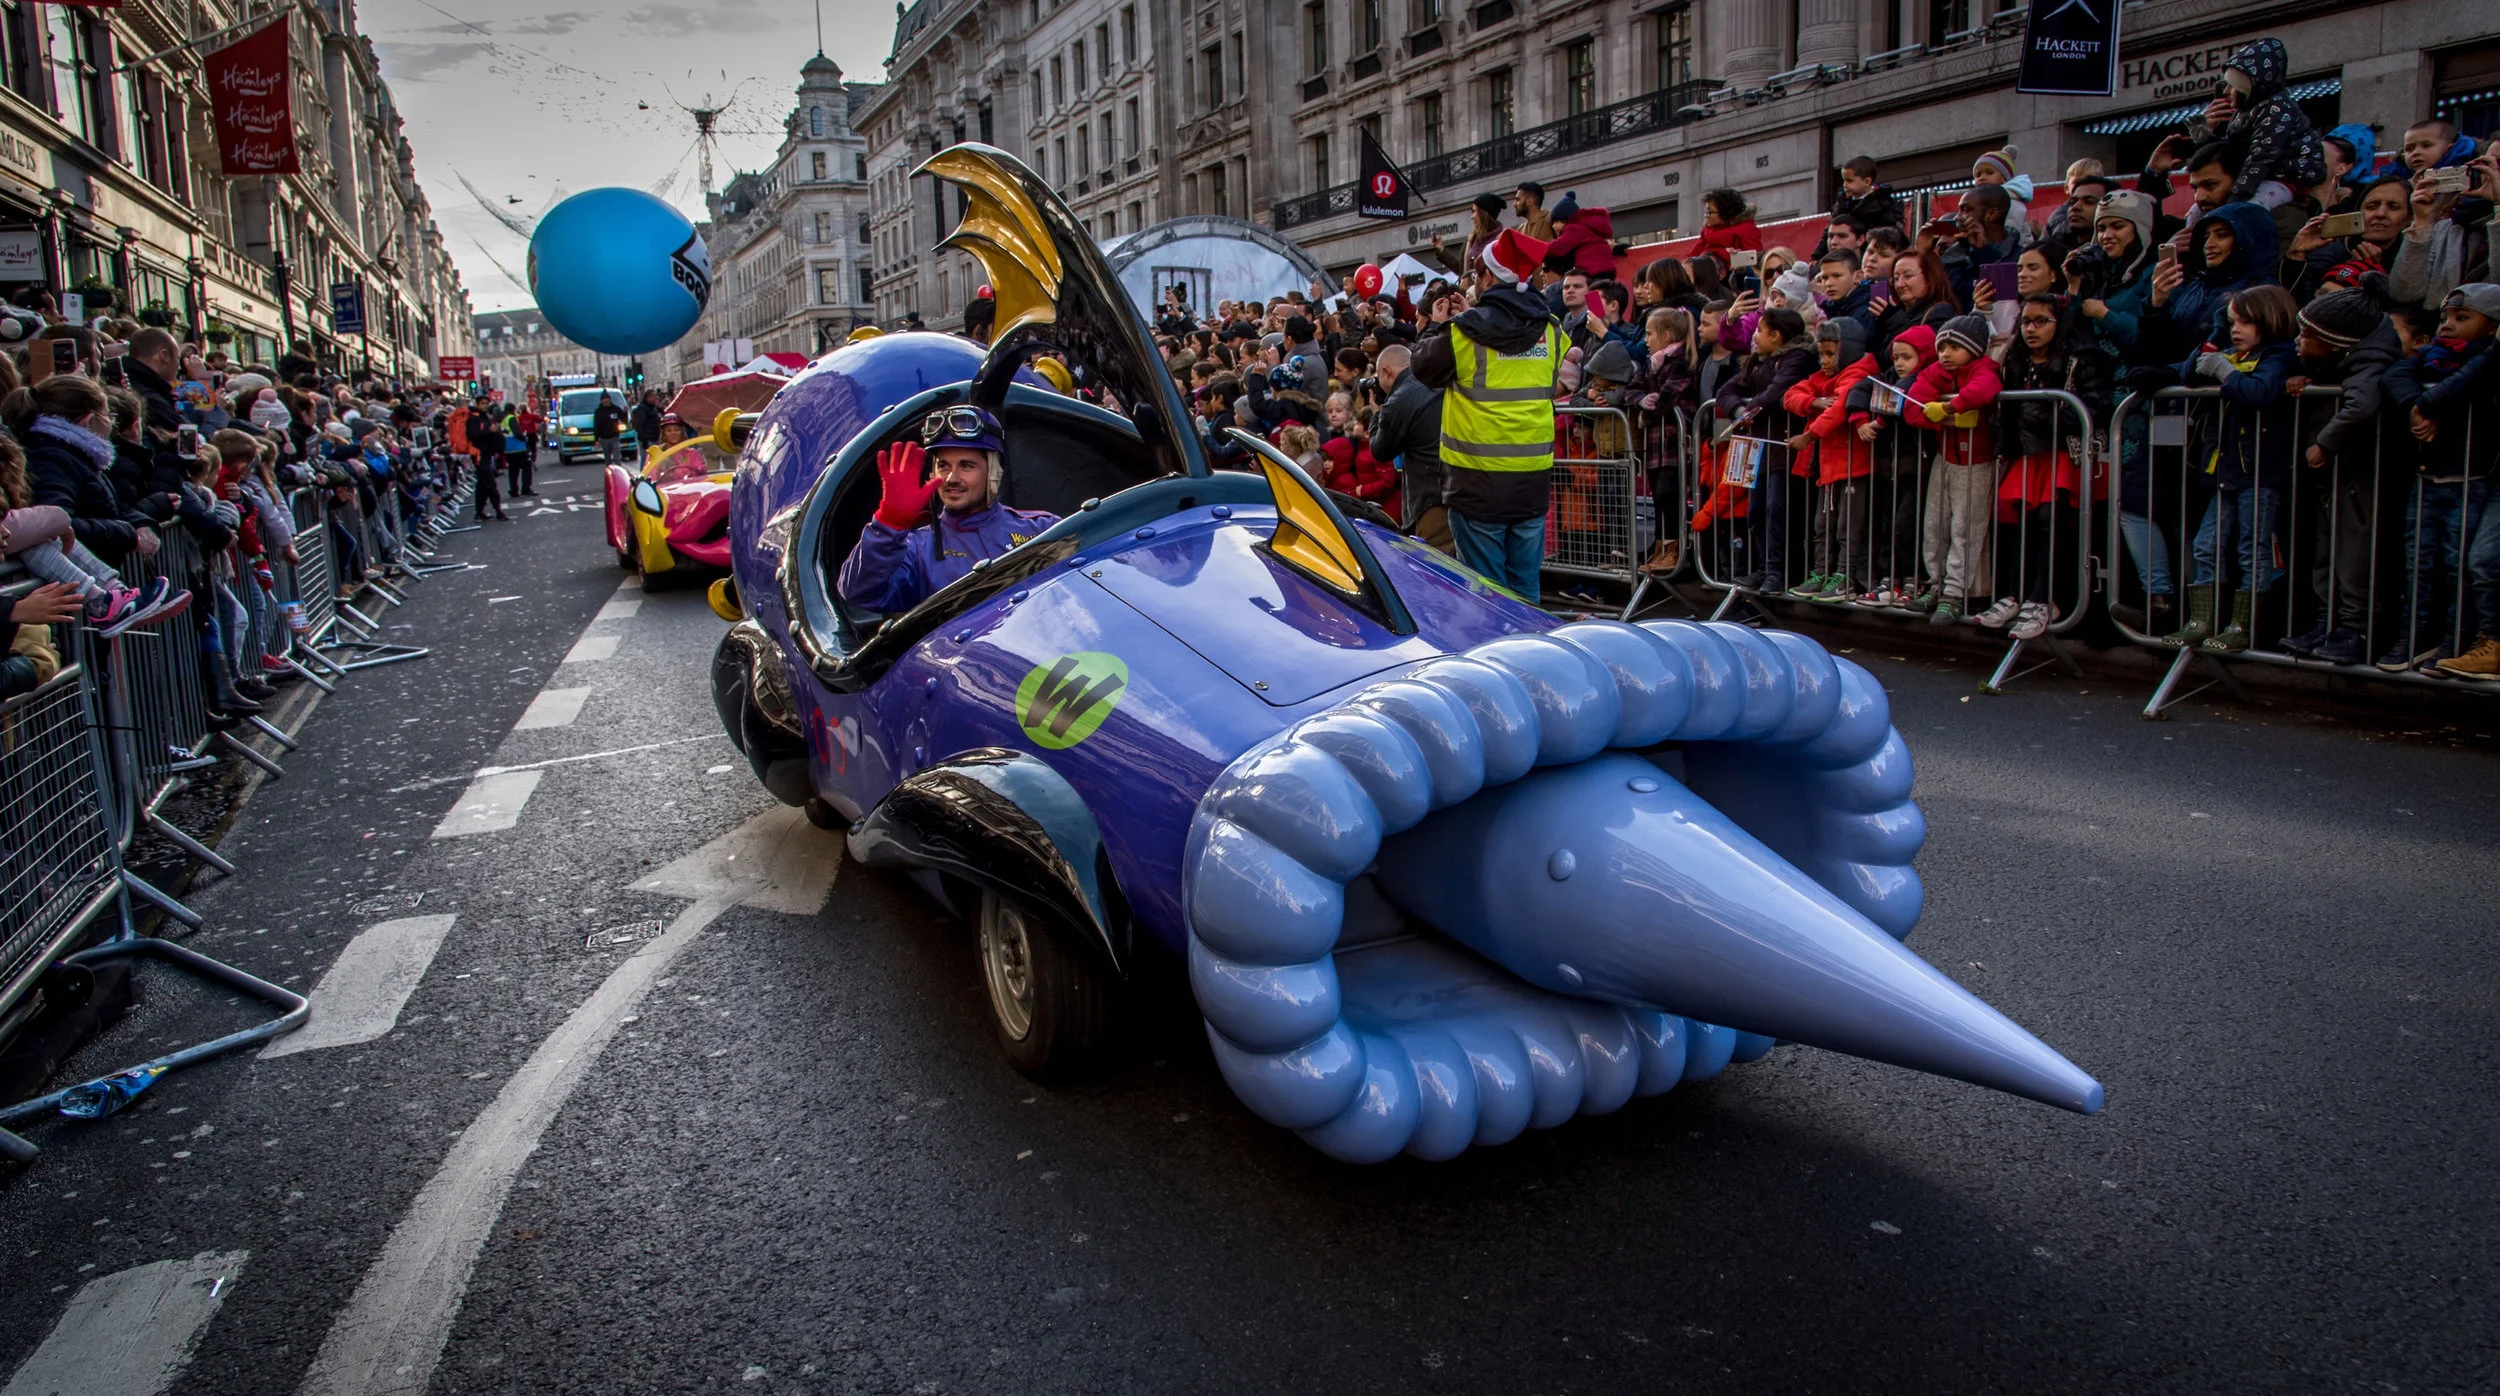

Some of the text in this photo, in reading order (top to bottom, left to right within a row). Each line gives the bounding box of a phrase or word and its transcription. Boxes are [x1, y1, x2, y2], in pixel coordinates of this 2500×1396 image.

[2035, 36, 2100, 53] HACKETT
[2052, 51, 2087, 60] LONDON
[220, 63, 281, 95] Hamleys
[2153, 74, 2222, 98] LONDON
[226, 100, 285, 132] Hamleys
[0, 129, 36, 173] MLEYS
[231, 137, 288, 167] Hamleys
[1664, 172, 1680, 187] 189
[1362, 205, 1404, 217] lululemon
[672, 260, 708, 306] BOO
[1023, 656, 1125, 739] W
